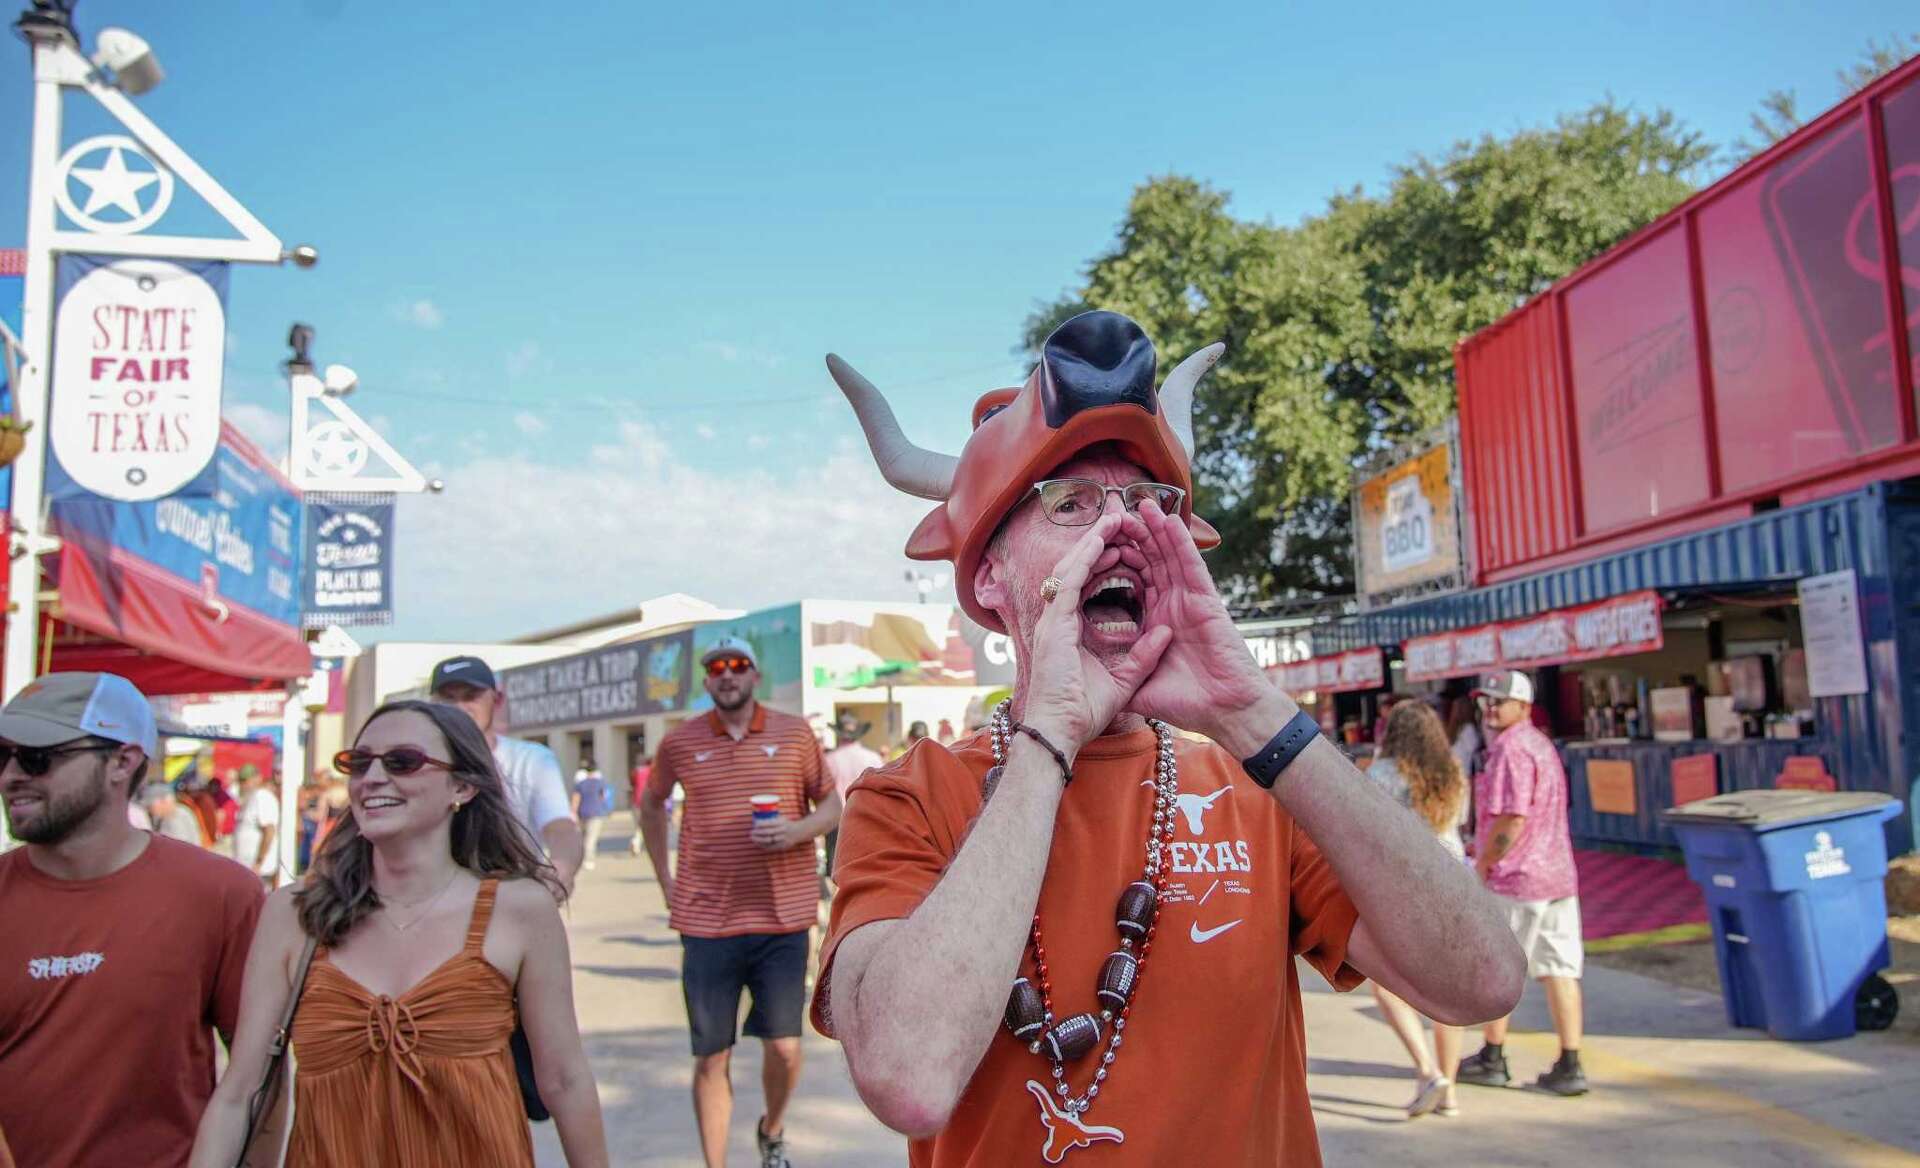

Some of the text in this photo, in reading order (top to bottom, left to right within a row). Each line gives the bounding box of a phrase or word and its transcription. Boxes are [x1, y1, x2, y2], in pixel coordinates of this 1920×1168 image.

[93, 305, 196, 352] STATE
[90, 357, 190, 382] FAIR
[124, 389, 156, 408] OF
[87, 412, 189, 453] TEXAS
[507, 650, 639, 699] COME TAKE A TRIP
